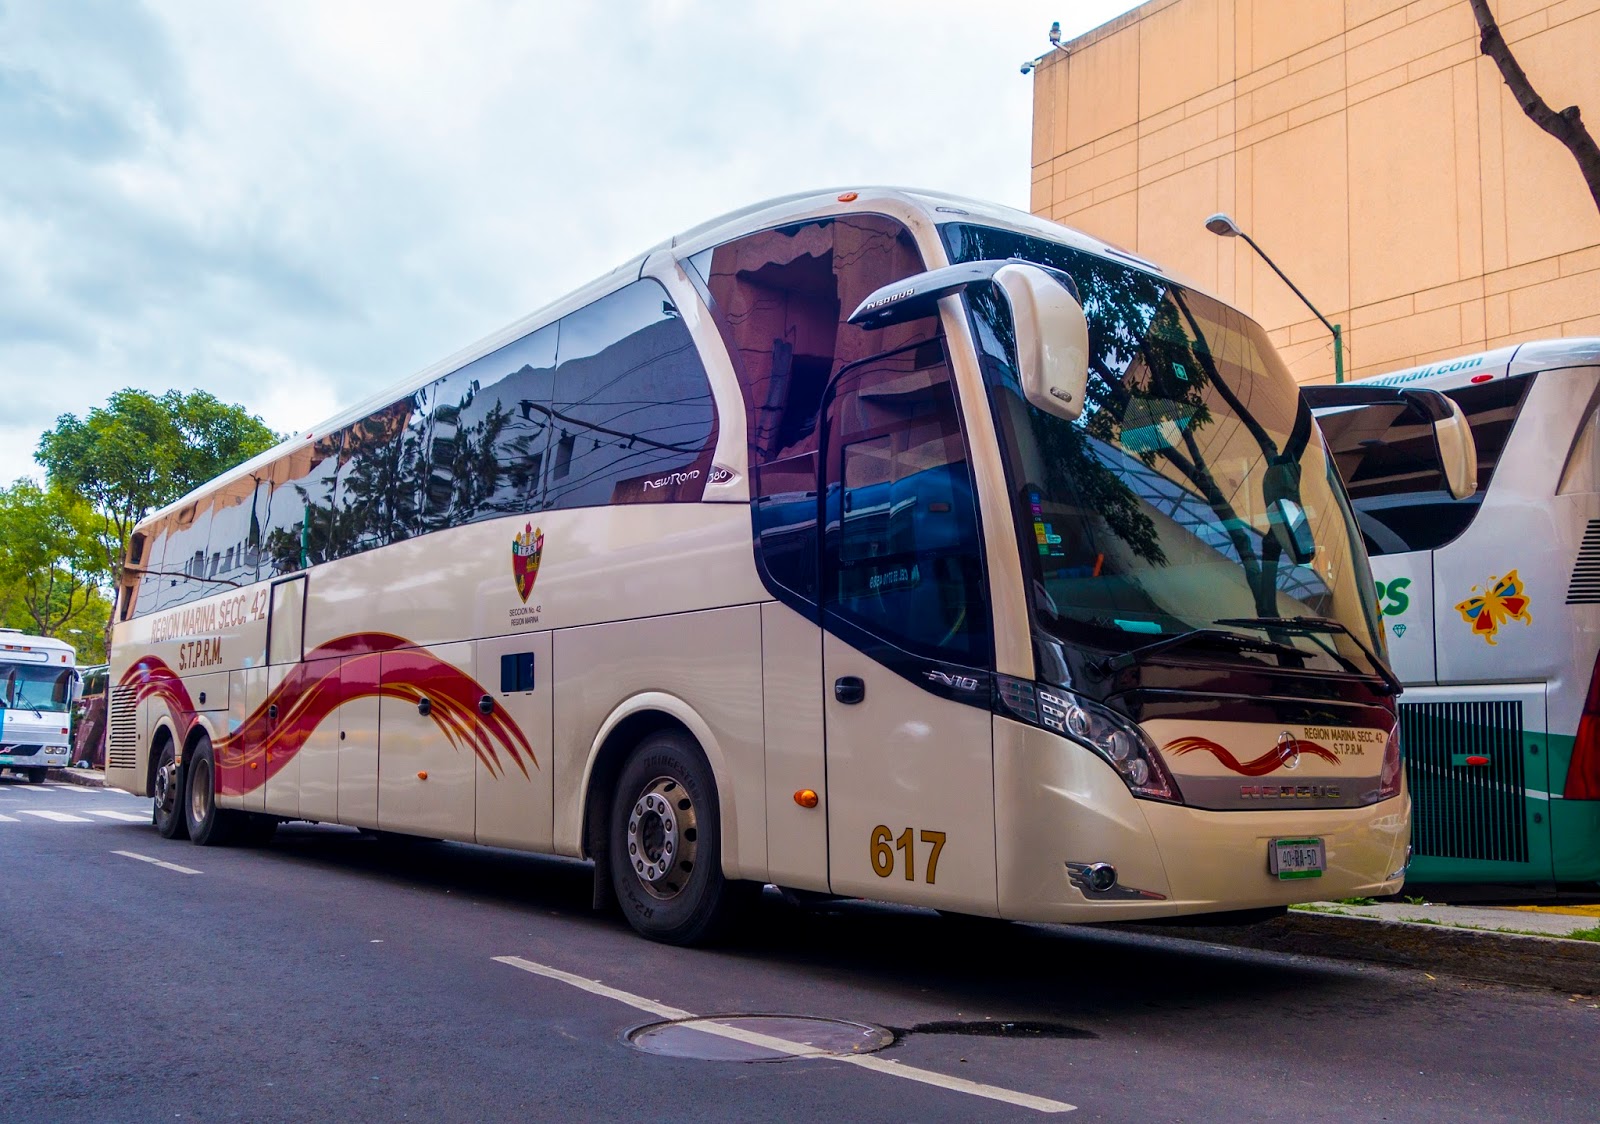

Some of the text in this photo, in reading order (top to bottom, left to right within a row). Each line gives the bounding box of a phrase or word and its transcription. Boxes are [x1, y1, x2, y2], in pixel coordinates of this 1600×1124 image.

[1361, 356, 1483, 387] otmail.com
[709, 469, 728, 484] 380
[150, 588, 267, 644] REGION MARINA SECC. 42
[179, 636, 223, 671] S.T.P.R.M.
[1303, 727, 1384, 744] REGION MARINA SECC. 42
[1333, 742, 1365, 756] S.T.P.R.M.
[1239, 784, 1342, 800] NEOBUS
[869, 824, 947, 885] 617
